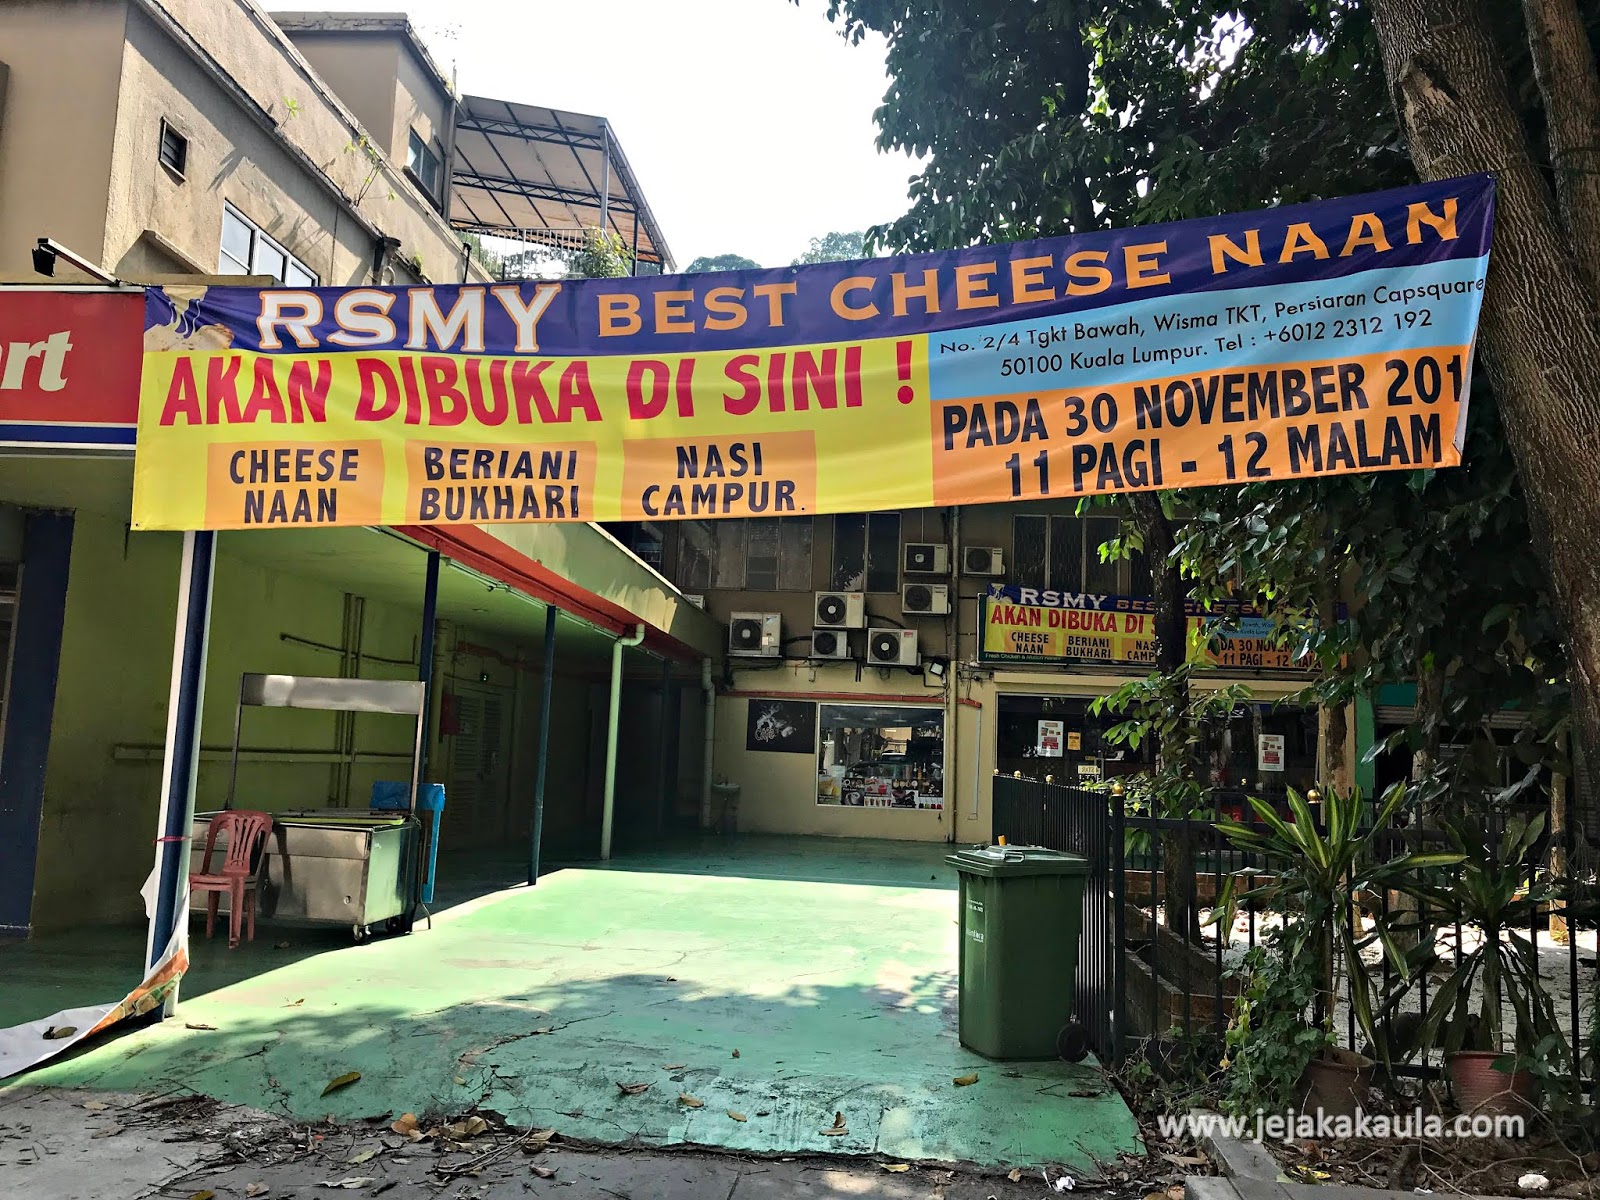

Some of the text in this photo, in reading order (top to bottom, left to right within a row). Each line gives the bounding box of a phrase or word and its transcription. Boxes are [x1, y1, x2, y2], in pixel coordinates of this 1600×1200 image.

[258, 196, 1461, 353] RSMY BEST CHEESE NAAN
[940, 275, 1485, 354] No. 2/4 Tgkt Bawah, Wisma TKT, Persiaran Capsquare
[1000, 353, 1063, 377] 50100
[1068, 346, 1125, 370] Kuala
[1132, 342, 1208, 368] Lumpur.
[1215, 333, 1245, 353] Tel
[1263, 321, 1326, 345] +6012
[1332, 317, 1384, 340] 2312
[1395, 308, 1433, 331] 192
[0, 330, 73, 392] rt
[159, 340, 914, 427] AKAN DIBUKA DI SINI !
[942, 398, 1048, 451] PADA
[1064, 392, 1119, 438] 30
[1135, 362, 1368, 431] NOVEMBER
[229, 448, 359, 485] CHEESE
[424, 447, 577, 482] BERIANI
[676, 442, 763, 479] NASI
[1005, 450, 1051, 497] 11
[1072, 438, 1162, 492] PAGI
[1217, 431, 1270, 480] 12
[1286, 413, 1443, 474] MALAM
[244, 488, 337, 524] NAAN
[418, 484, 579, 521] BUKHARI
[641, 480, 796, 516] CAMPUR
[1019, 587, 1108, 610] RSMY
[1116, 599, 1156, 611] BES
[990, 605, 1041, 627] AKAN
[1048, 610, 1118, 632] DIBUKA
[1124, 613, 1144, 634] DI
[1011, 632, 1049, 644] CHEESE
[1015, 644, 1044, 654] NAAN
[1066, 647, 1111, 659] BUKHARI
[1068, 636, 1110, 647] BERIANI
[1127, 650, 1156, 661] CAMP
[1135, 640, 1156, 651] NAS
[1239, 640, 1253, 651] 30
[1223, 653, 1235, 665] 11
[1239, 653, 1263, 665] PAGI
[1276, 655, 1289, 667] 12
